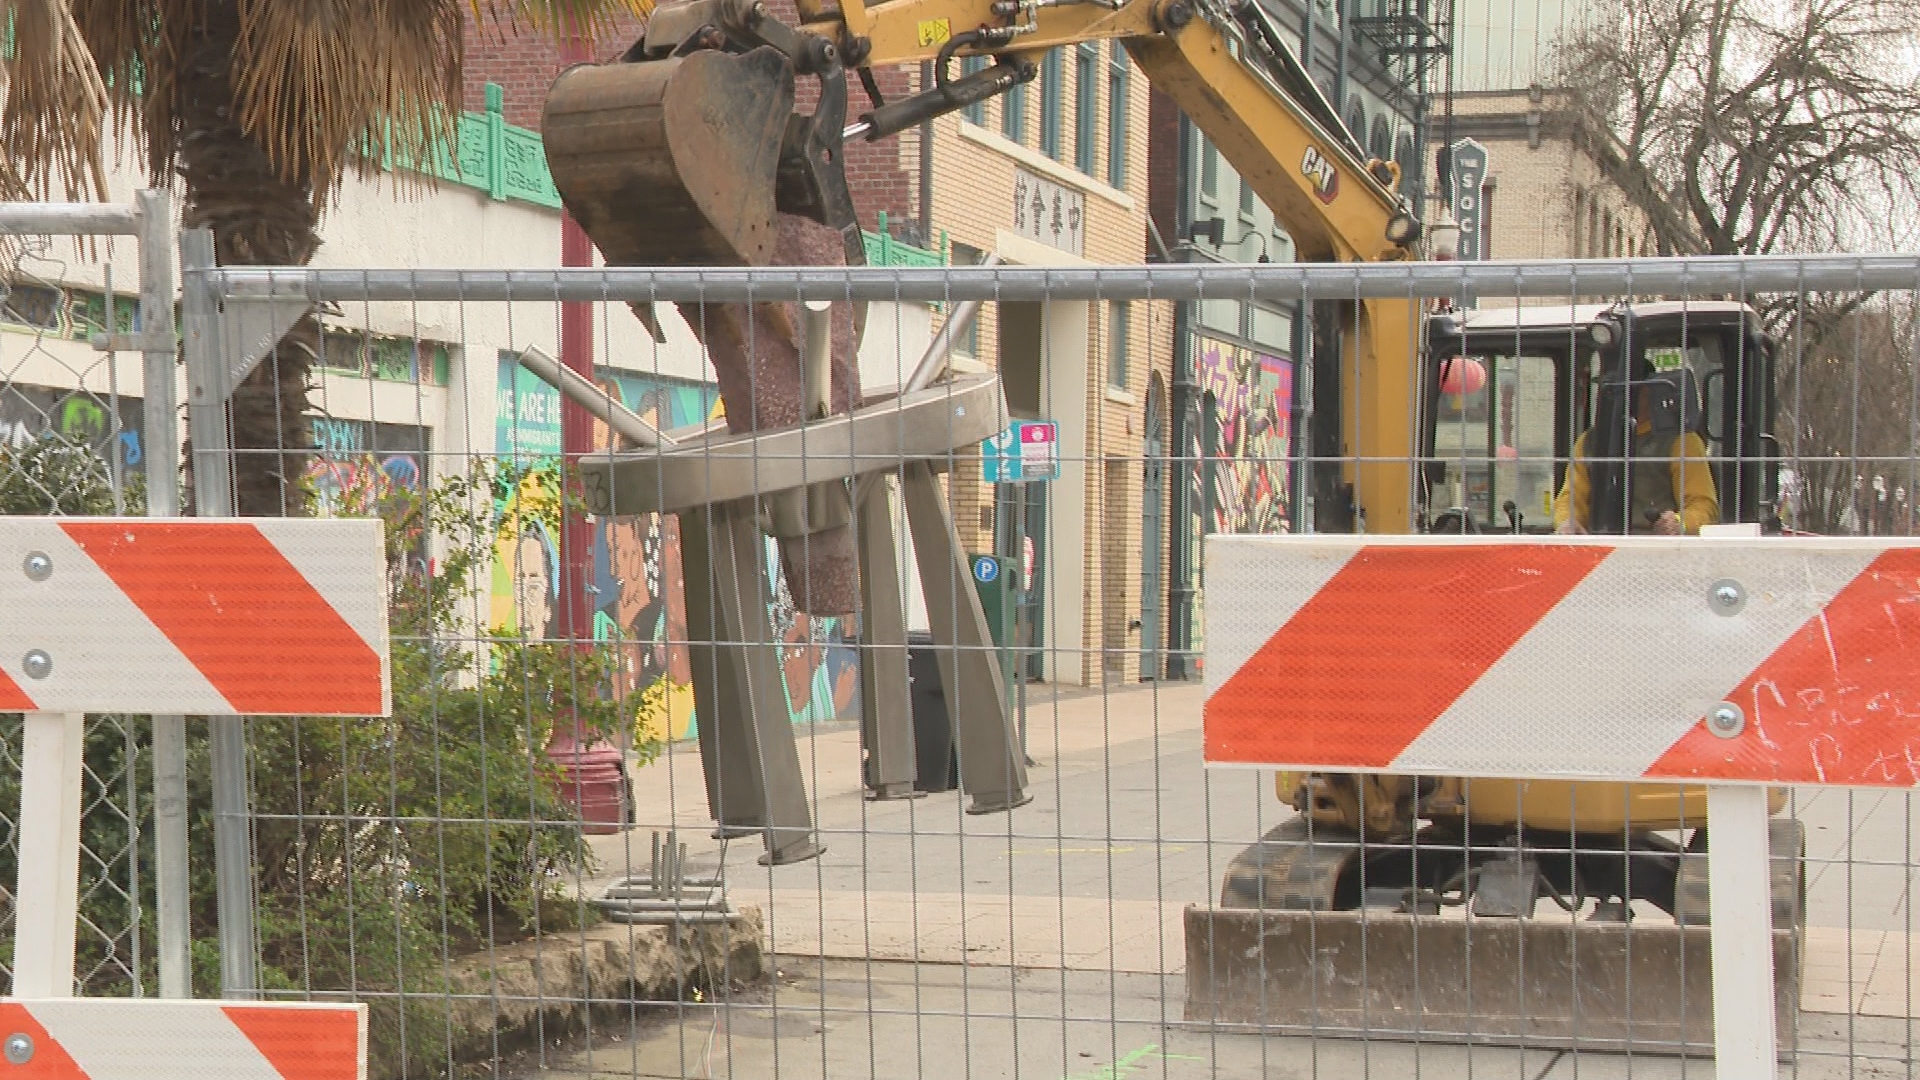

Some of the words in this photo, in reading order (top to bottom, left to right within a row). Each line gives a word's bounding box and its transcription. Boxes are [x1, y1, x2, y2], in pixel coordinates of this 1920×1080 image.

[1301, 145, 1336, 193] CAT
[1460, 158, 1479, 168] THE
[496, 388, 514, 420] WE
[519, 391, 545, 424] ARE
[981, 562, 993, 578] P
